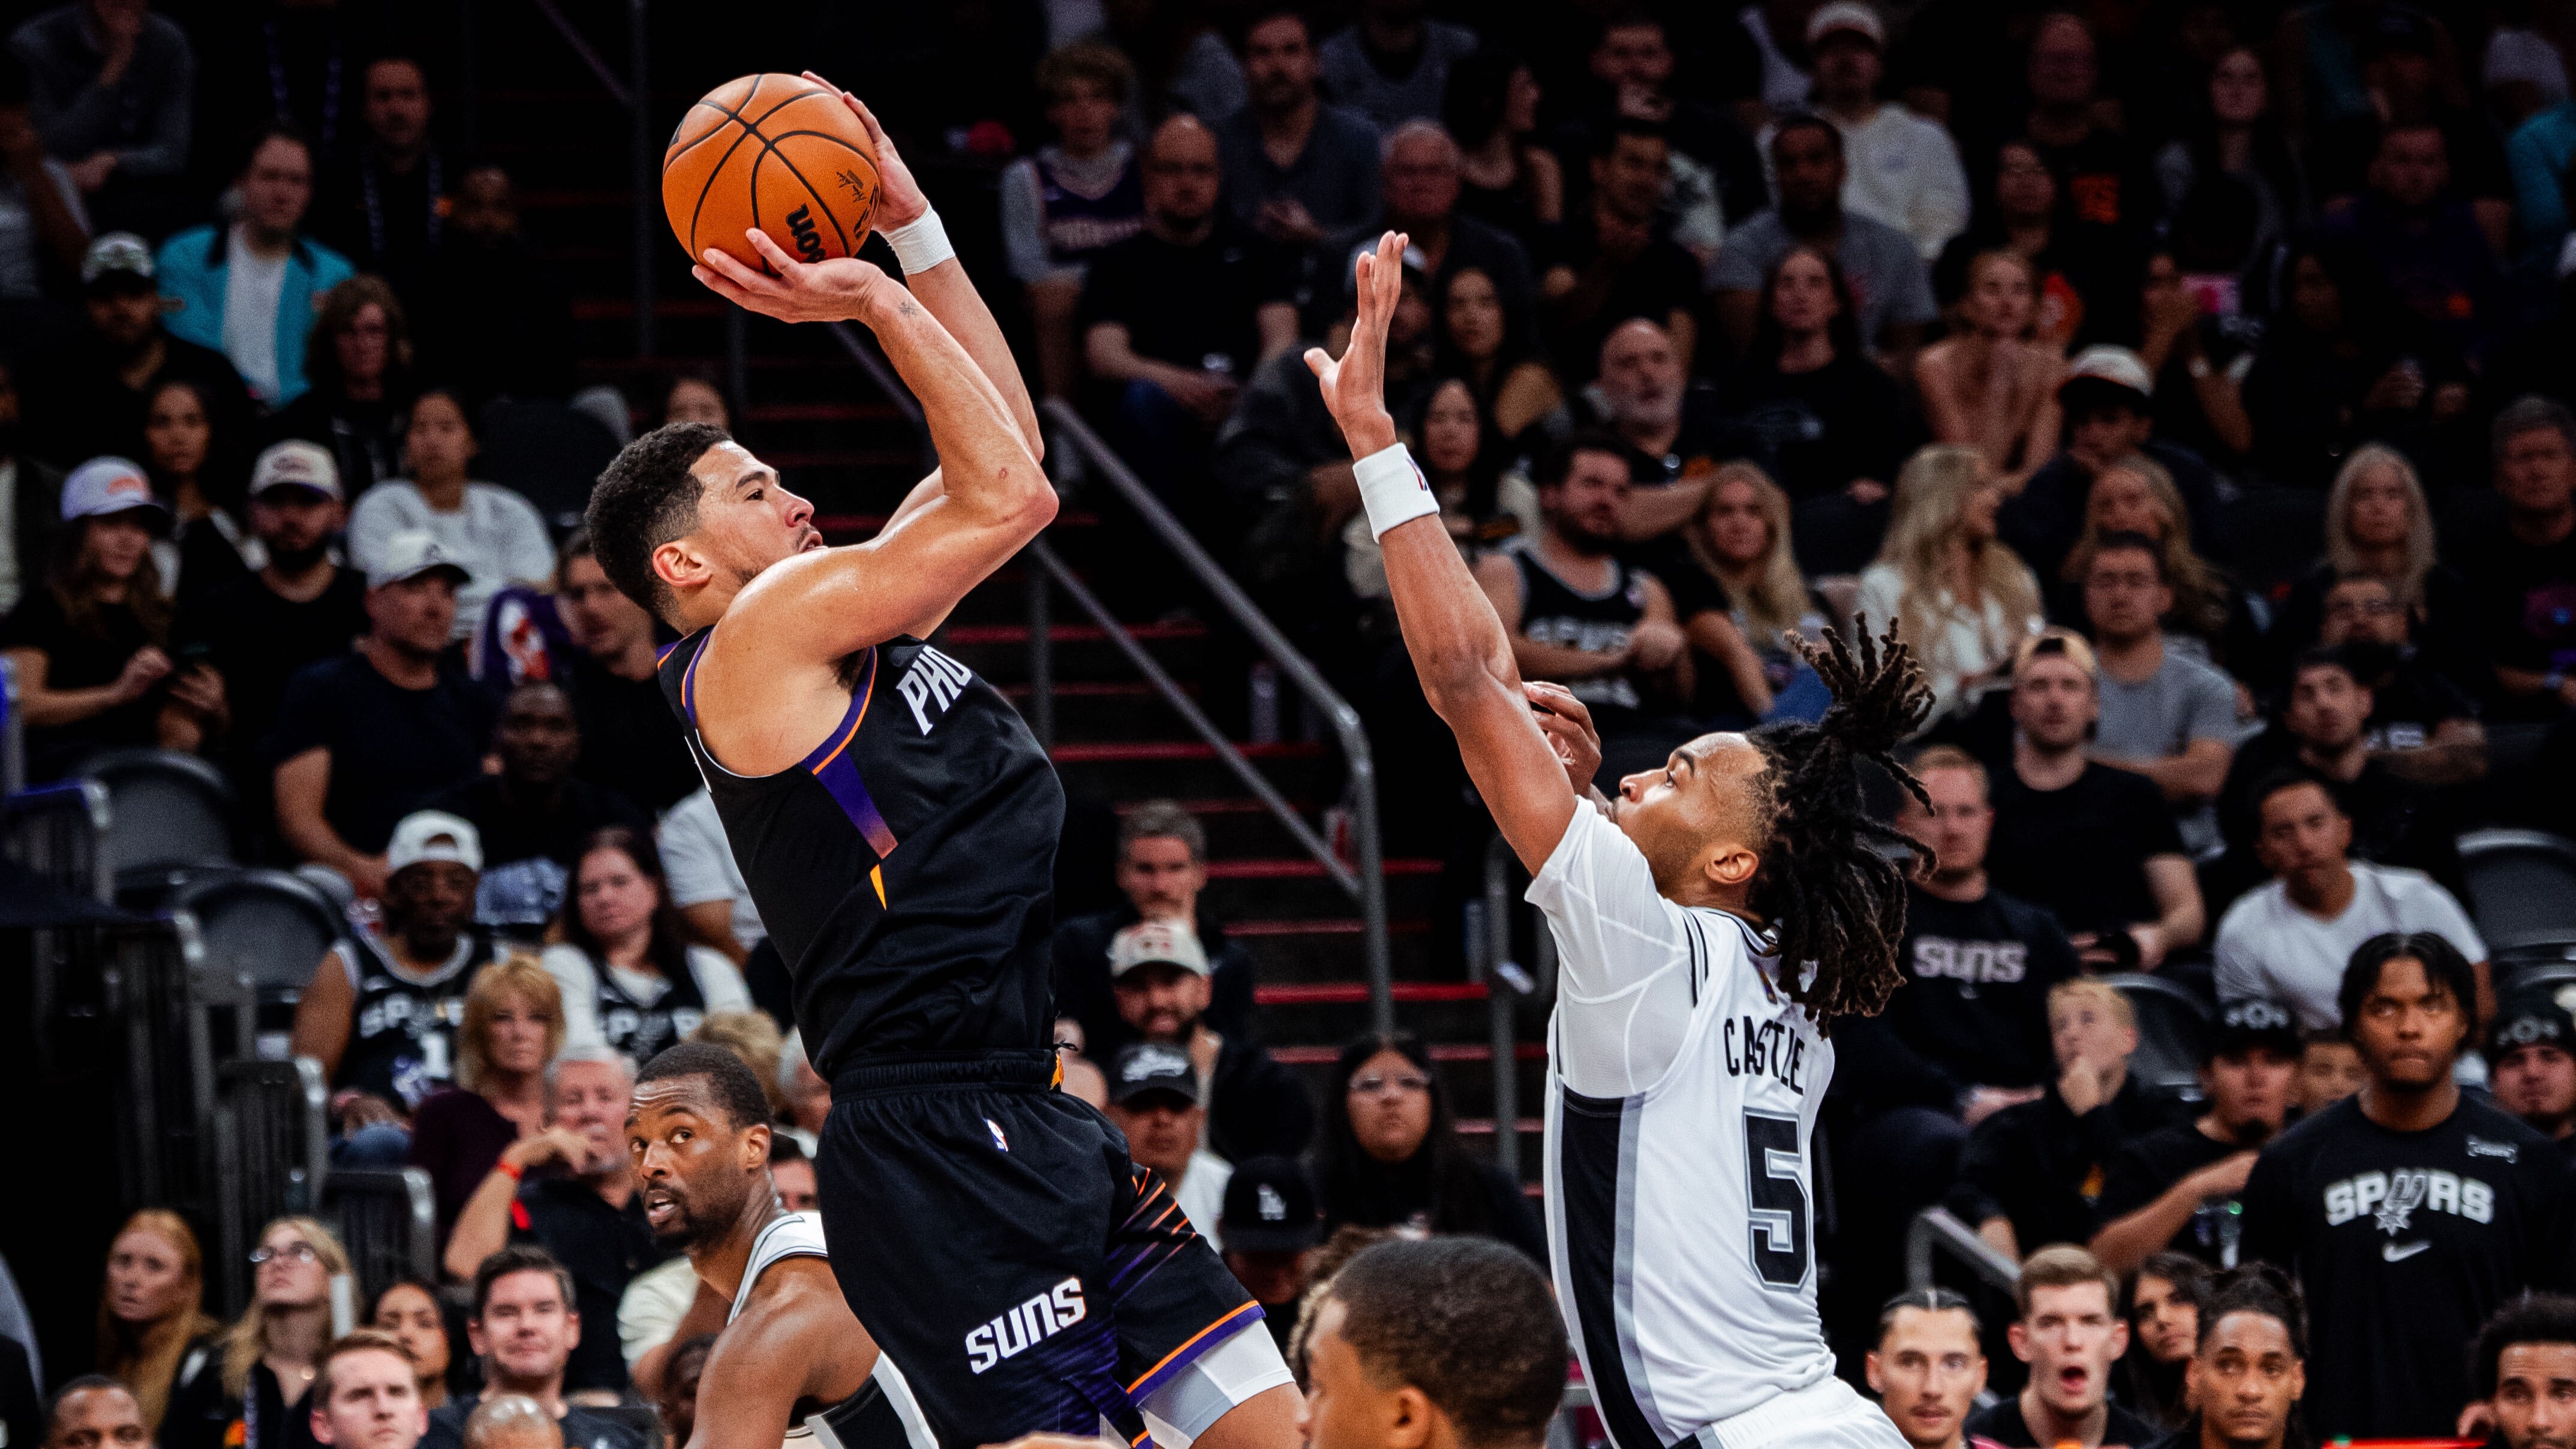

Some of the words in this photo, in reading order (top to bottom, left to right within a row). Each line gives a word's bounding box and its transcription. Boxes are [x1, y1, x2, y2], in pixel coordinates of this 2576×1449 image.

[1911, 934, 2028, 984] SUNS
[1724, 1015, 1805, 1096] CASTLE
[1742, 1105, 1812, 1294] 5
[2323, 1167, 2496, 1233] SPURS
[965, 1276, 1087, 1375] SUNS
